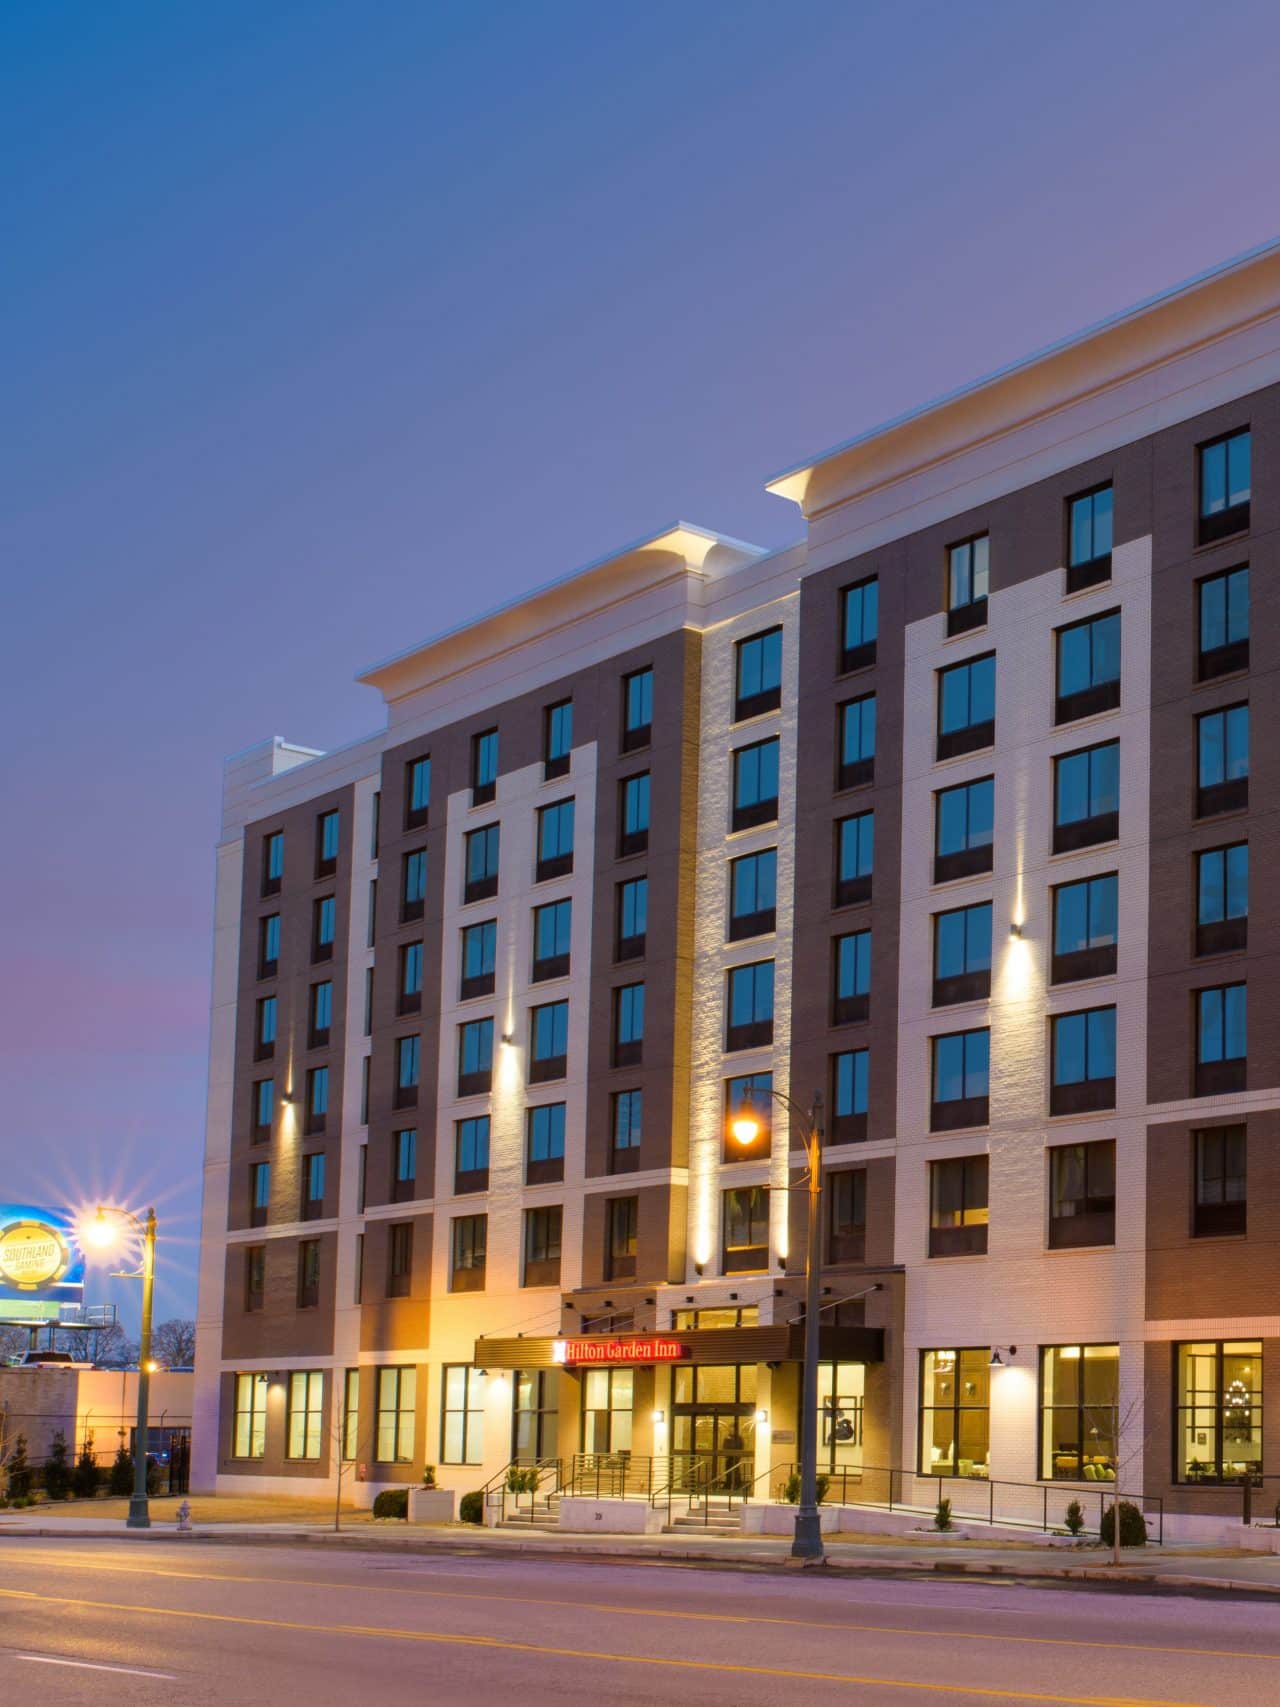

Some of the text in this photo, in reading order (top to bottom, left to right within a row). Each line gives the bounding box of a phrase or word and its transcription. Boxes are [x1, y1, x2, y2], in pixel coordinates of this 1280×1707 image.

[567, 1340, 677, 1360] Hilton Garden Inn
